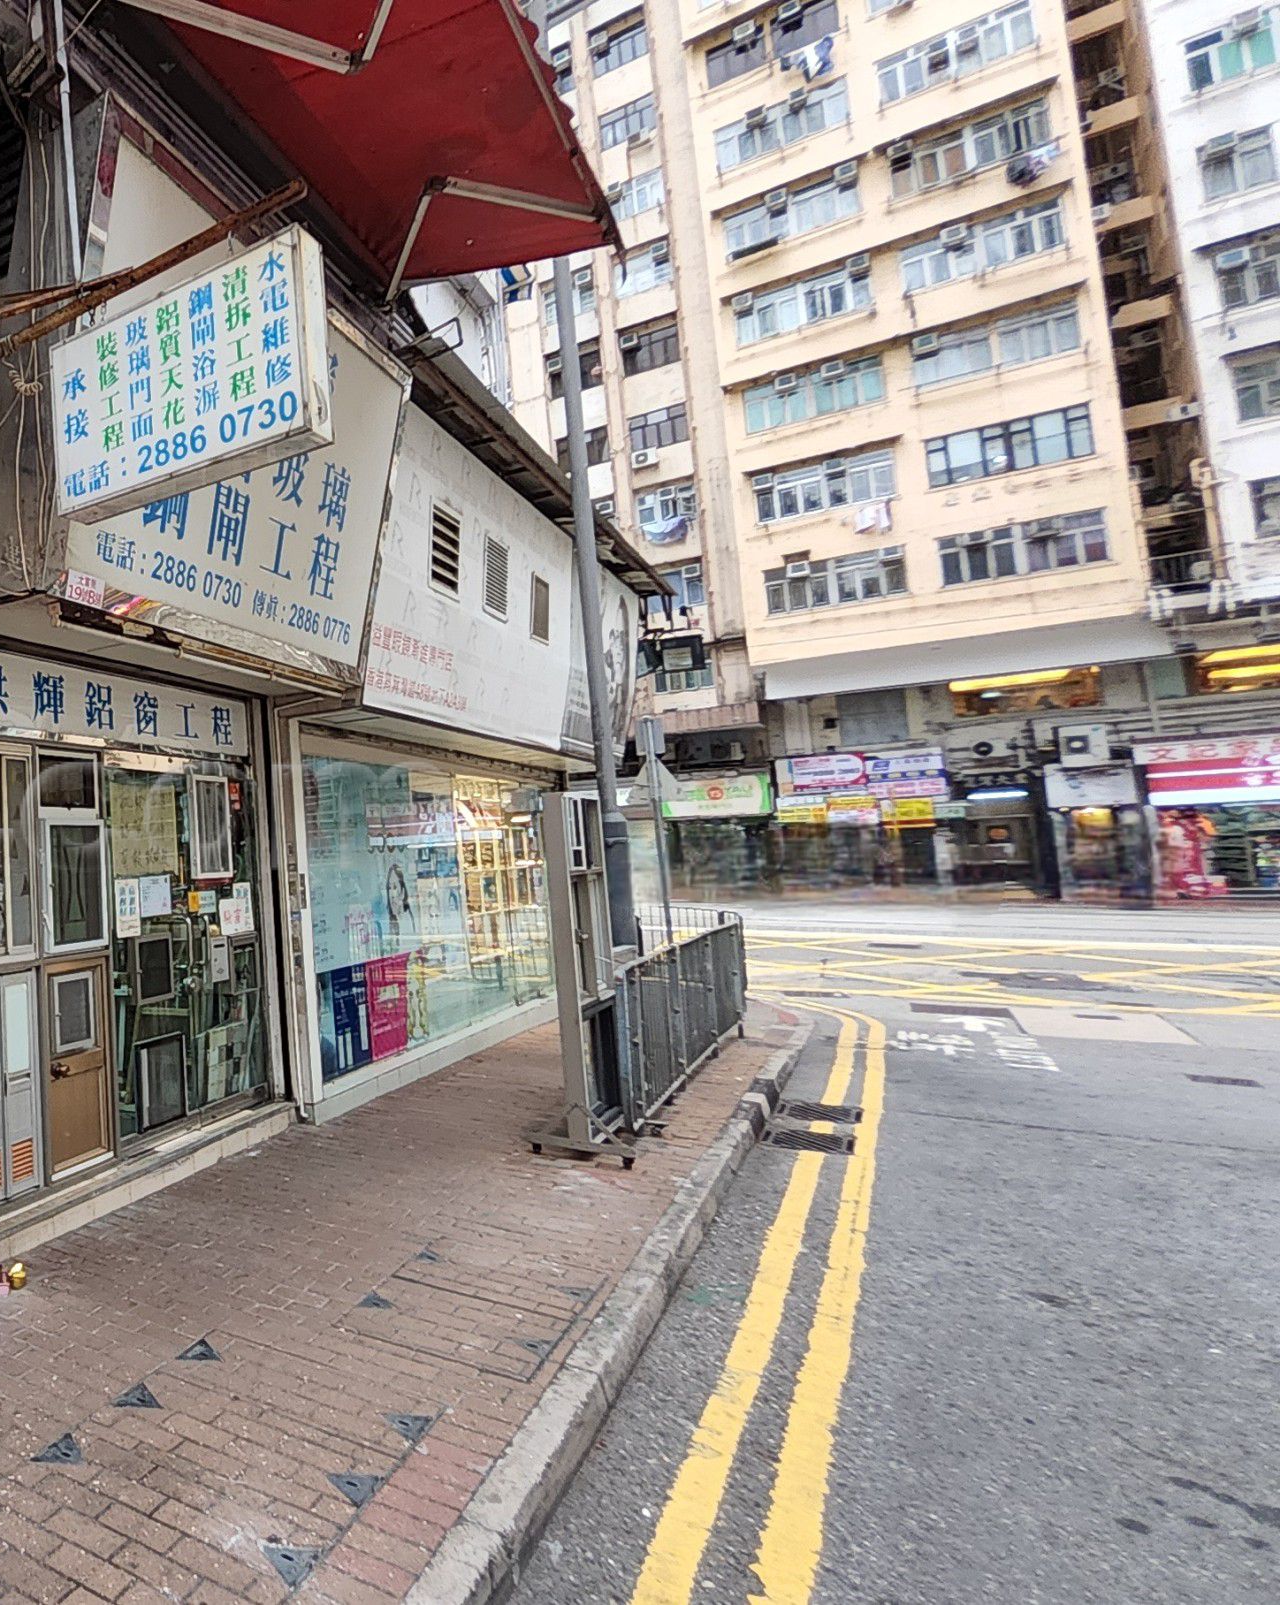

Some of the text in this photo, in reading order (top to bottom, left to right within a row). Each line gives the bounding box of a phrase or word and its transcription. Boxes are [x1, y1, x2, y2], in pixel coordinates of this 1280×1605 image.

[125, 315, 154, 443] 玻璃門面
[155, 300, 186, 429] 鋁質天花
[222, 265, 257, 402] 清拆工程
[257, 250, 293, 390] 水電維修
[62, 367, 90, 445] 承接
[96, 331, 125, 453] 裝修工程
[137, 423, 207, 474] 2886
[220, 390, 298, 444] 0730
[150, 550, 198, 593] 2886
[202, 571, 242, 609] 0730
[288, 603, 320, 636] 2886
[322, 616, 351, 646] 0776
